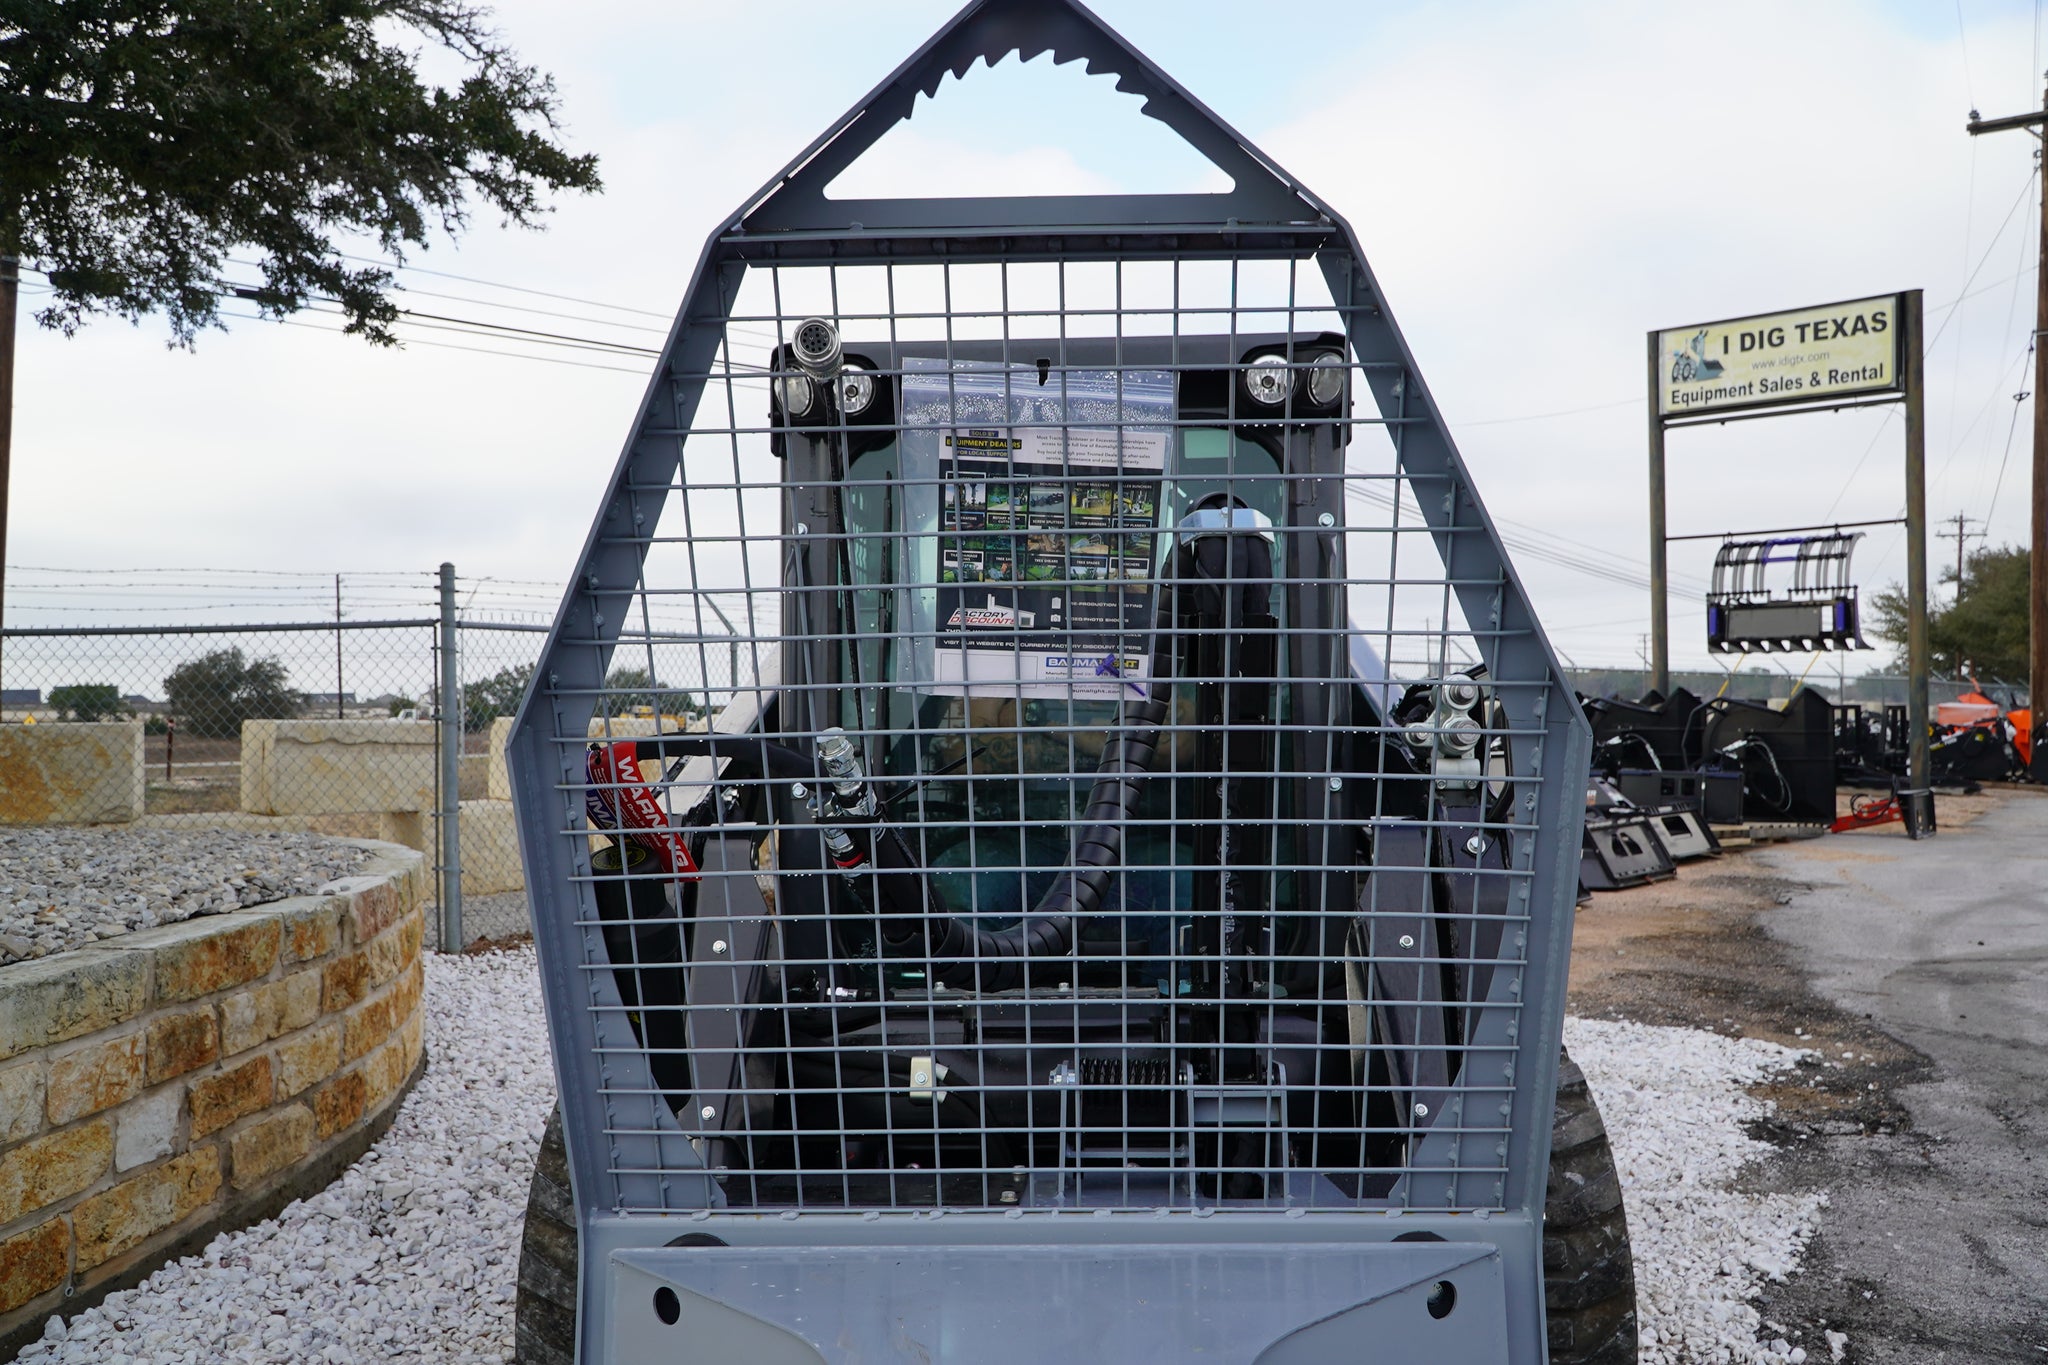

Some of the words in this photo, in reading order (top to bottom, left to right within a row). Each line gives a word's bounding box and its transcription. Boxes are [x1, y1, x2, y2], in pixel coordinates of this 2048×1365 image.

[1723, 335, 1729, 355] I
[1740, 327, 1785, 353] DIG
[1794, 311, 1887, 343] TEXAS
[1751, 352, 1830, 370] www.idigtx.com
[1671, 380, 1753, 407] Equipment
[1759, 376, 1803, 394] Sales
[1809, 371, 1821, 387] &
[1828, 362, 1883, 385] Rental
[946, 438, 988, 447] EUIPMENT
